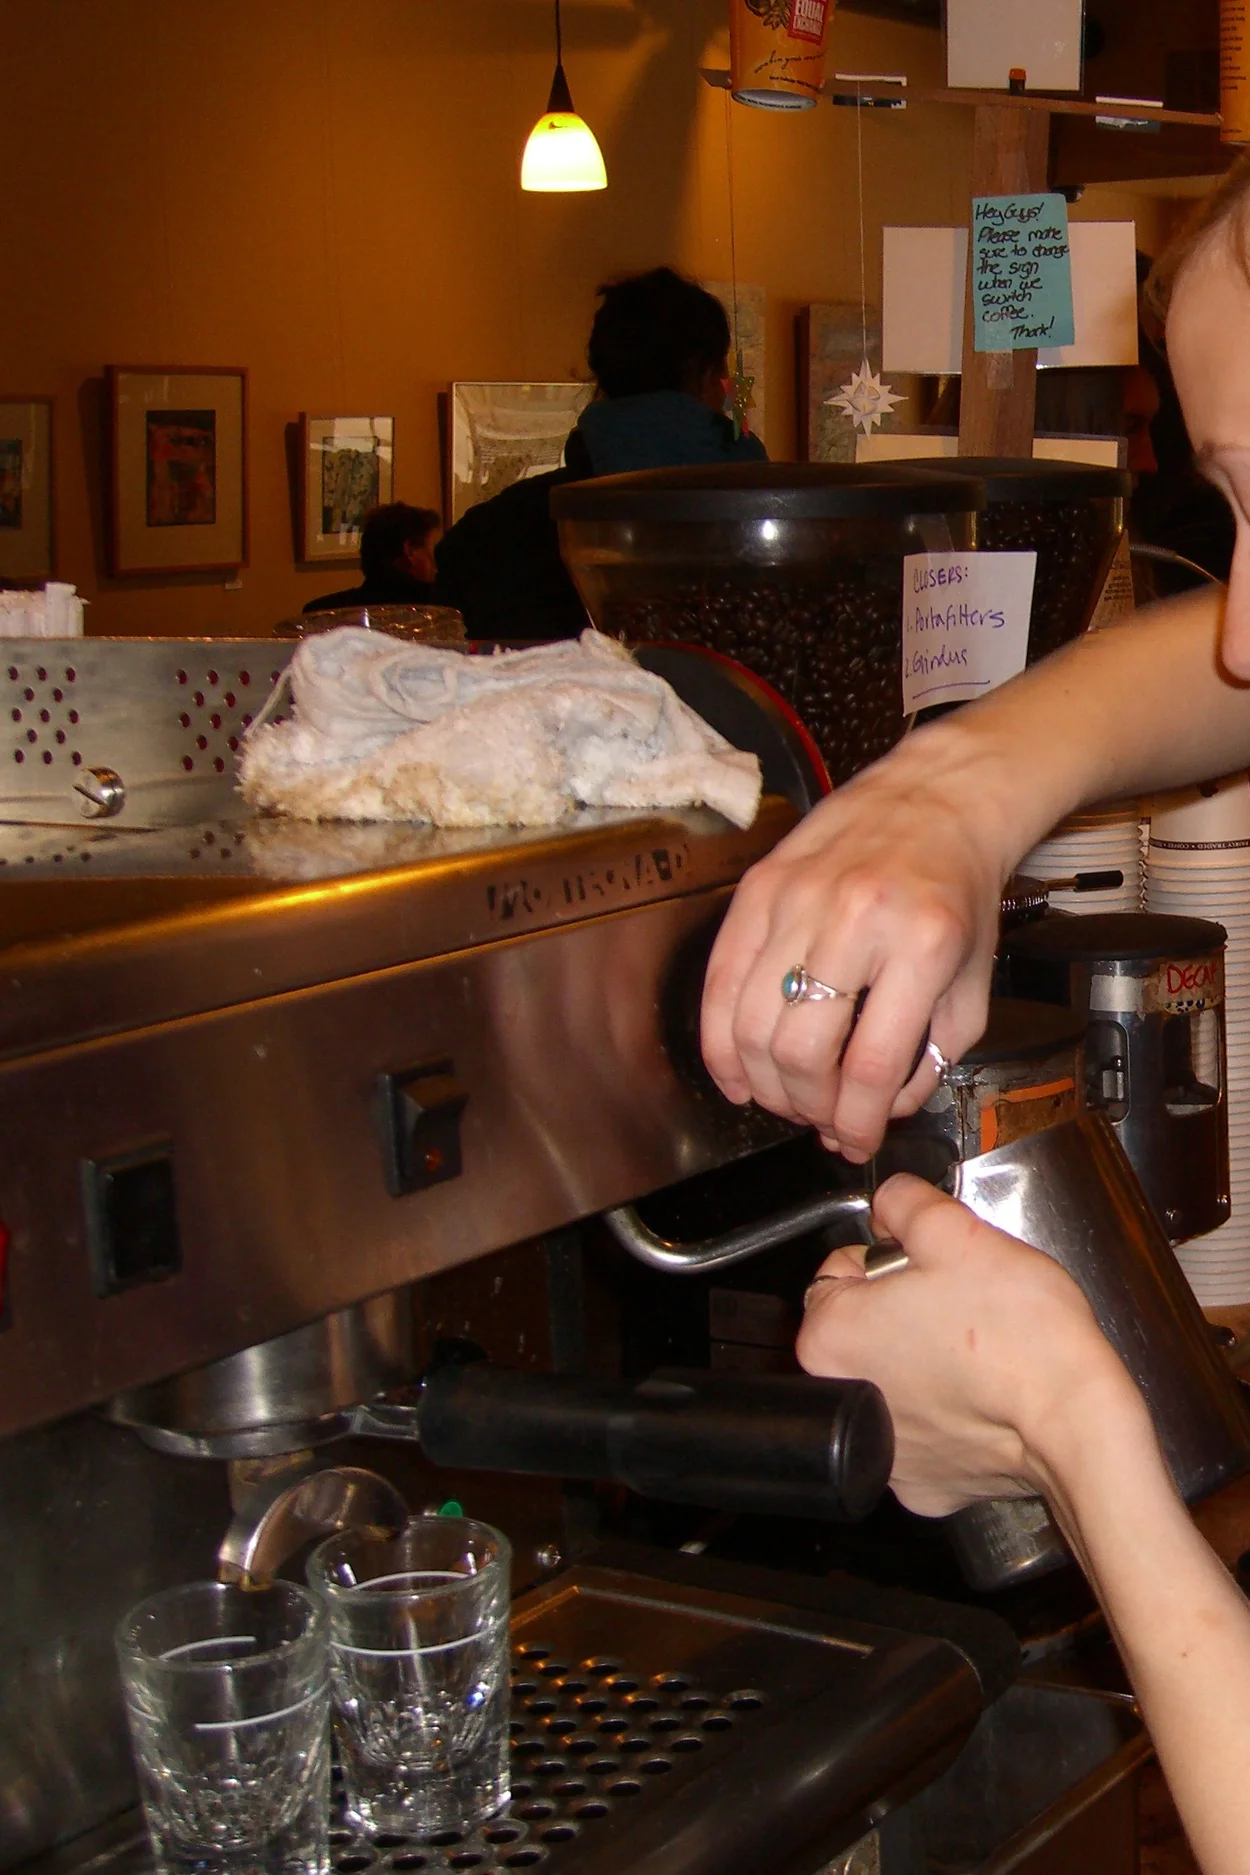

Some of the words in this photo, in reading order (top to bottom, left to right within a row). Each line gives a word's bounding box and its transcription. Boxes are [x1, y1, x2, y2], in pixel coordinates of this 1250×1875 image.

[976, 202, 1004, 226] Hey
[1004, 202, 1045, 224] Guys!
[977, 227, 1020, 243] Please
[1028, 227, 1062, 242] make
[979, 248, 1008, 260] sure
[1011, 244, 1027, 256] to
[1032, 244, 1070, 258] change
[977, 258, 1002, 275] the
[1008, 261, 1040, 279] sign
[978, 274, 1012, 291] when
[1019, 277, 1043, 290] we
[982, 289, 1032, 306] switch
[982, 305, 1035, 322] coffee.
